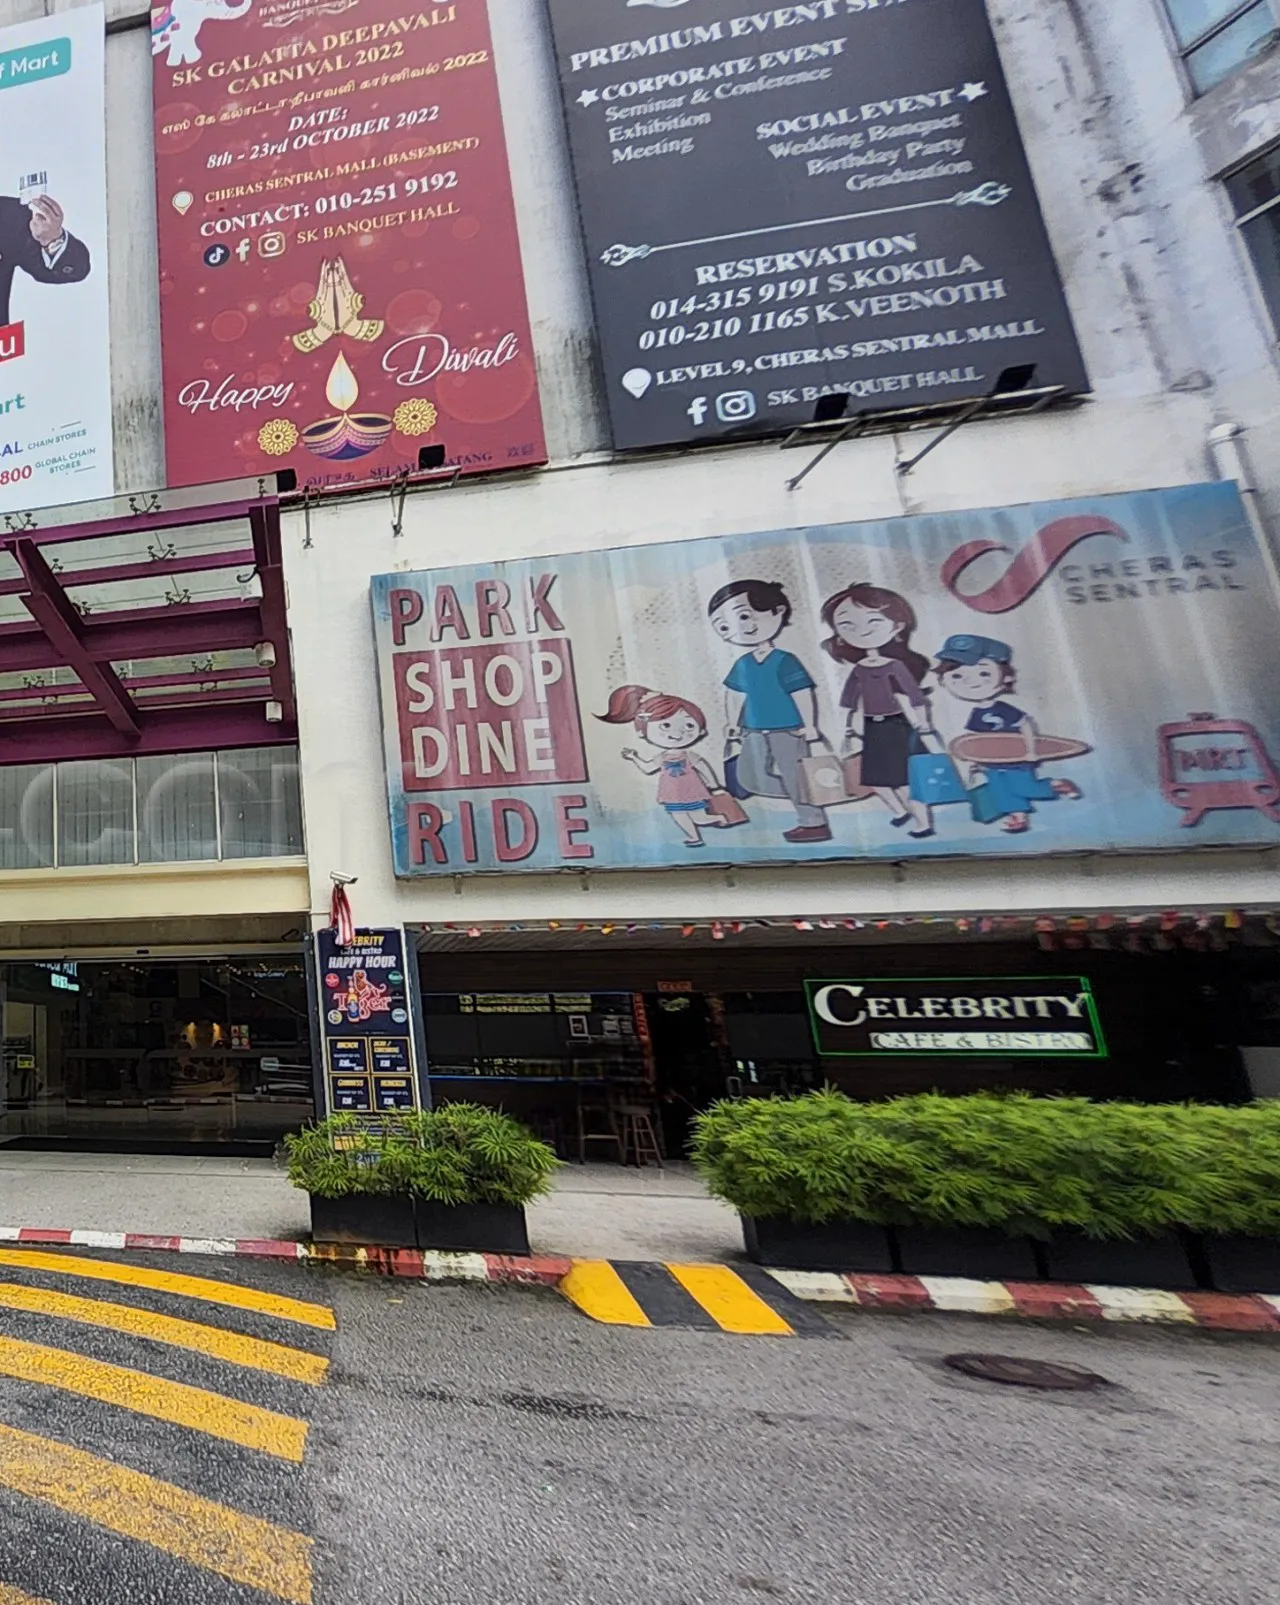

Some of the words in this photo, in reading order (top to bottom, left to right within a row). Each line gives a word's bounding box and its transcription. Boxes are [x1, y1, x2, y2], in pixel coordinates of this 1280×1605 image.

[172, 68, 202, 88] SK
[208, 39, 317, 79] GALATTA
[323, 6, 457, 50] DEEPAVALI
[571, 22, 721, 72] PREMIUM
[731, 0, 840, 38] EVENT
[11, 51, 59, 77] Mart
[228, 54, 351, 95] CARNIVAL
[356, 42, 404, 67] 2022
[443, 50, 489, 72] 2022
[601, 56, 756, 101] CORPORATE
[759, 37, 848, 70] EVENT
[288, 108, 350, 132] DATE:
[605, 95, 686, 122] Seminar
[690, 88, 712, 105] &
[756, 107, 859, 141] SOCIAL
[860, 88, 955, 121] EVENT
[207, 151, 233, 169] 8th
[250, 141, 288, 162] 23rd
[293, 116, 389, 150] OCTOBER
[397, 105, 440, 128] 2022
[608, 112, 712, 143] Exhibition
[205, 180, 263, 203] CHERAS
[266, 168, 335, 191] SENTRAL
[337, 155, 381, 177] MALL
[383, 137, 480, 168] (BASEMENT)
[612, 137, 695, 164] Meeting
[200, 204, 310, 238] CONTACT:
[315, 182, 397, 216] 010-251
[405, 171, 459, 197] 9192
[297, 229, 319, 245] SK
[324, 211, 405, 240] BANQUET
[410, 202, 460, 223] HALL
[695, 232, 918, 286] RESERVATION
[650, 285, 751, 321] 014-315
[758, 277, 819, 305] 9191
[639, 317, 741, 351] 010-210
[748, 306, 810, 335] 1165
[754, 343, 849, 371] CHERAS
[851, 329, 964, 359] SENTRAL
[965, 318, 1045, 343] MALL
[178, 374, 295, 414] Happy
[382, 332, 519, 386] Diwali
[767, 388, 799, 407] SK
[916, 365, 986, 387] HALL
[28, 438, 53, 450] CHAIN
[55, 429, 87, 444] STORES
[35, 455, 67, 469] GLOBAL
[50, 460, 81, 474] STORES
[1059, 549, 1237, 583] CHERAS
[389, 573, 565, 646] PARK
[1066, 575, 1245, 605] SENTRAL
[405, 652, 563, 713] SHOP
[411, 718, 556, 778] DINE
[406, 794, 594, 864] RIDE
[328, 956, 363, 969] HAPPY
[365, 955, 397, 969] HOUR
[814, 984, 1091, 1027] CELEBRITY
[873, 1032, 946, 1049] CAFE
[956, 1034, 974, 1048] &
